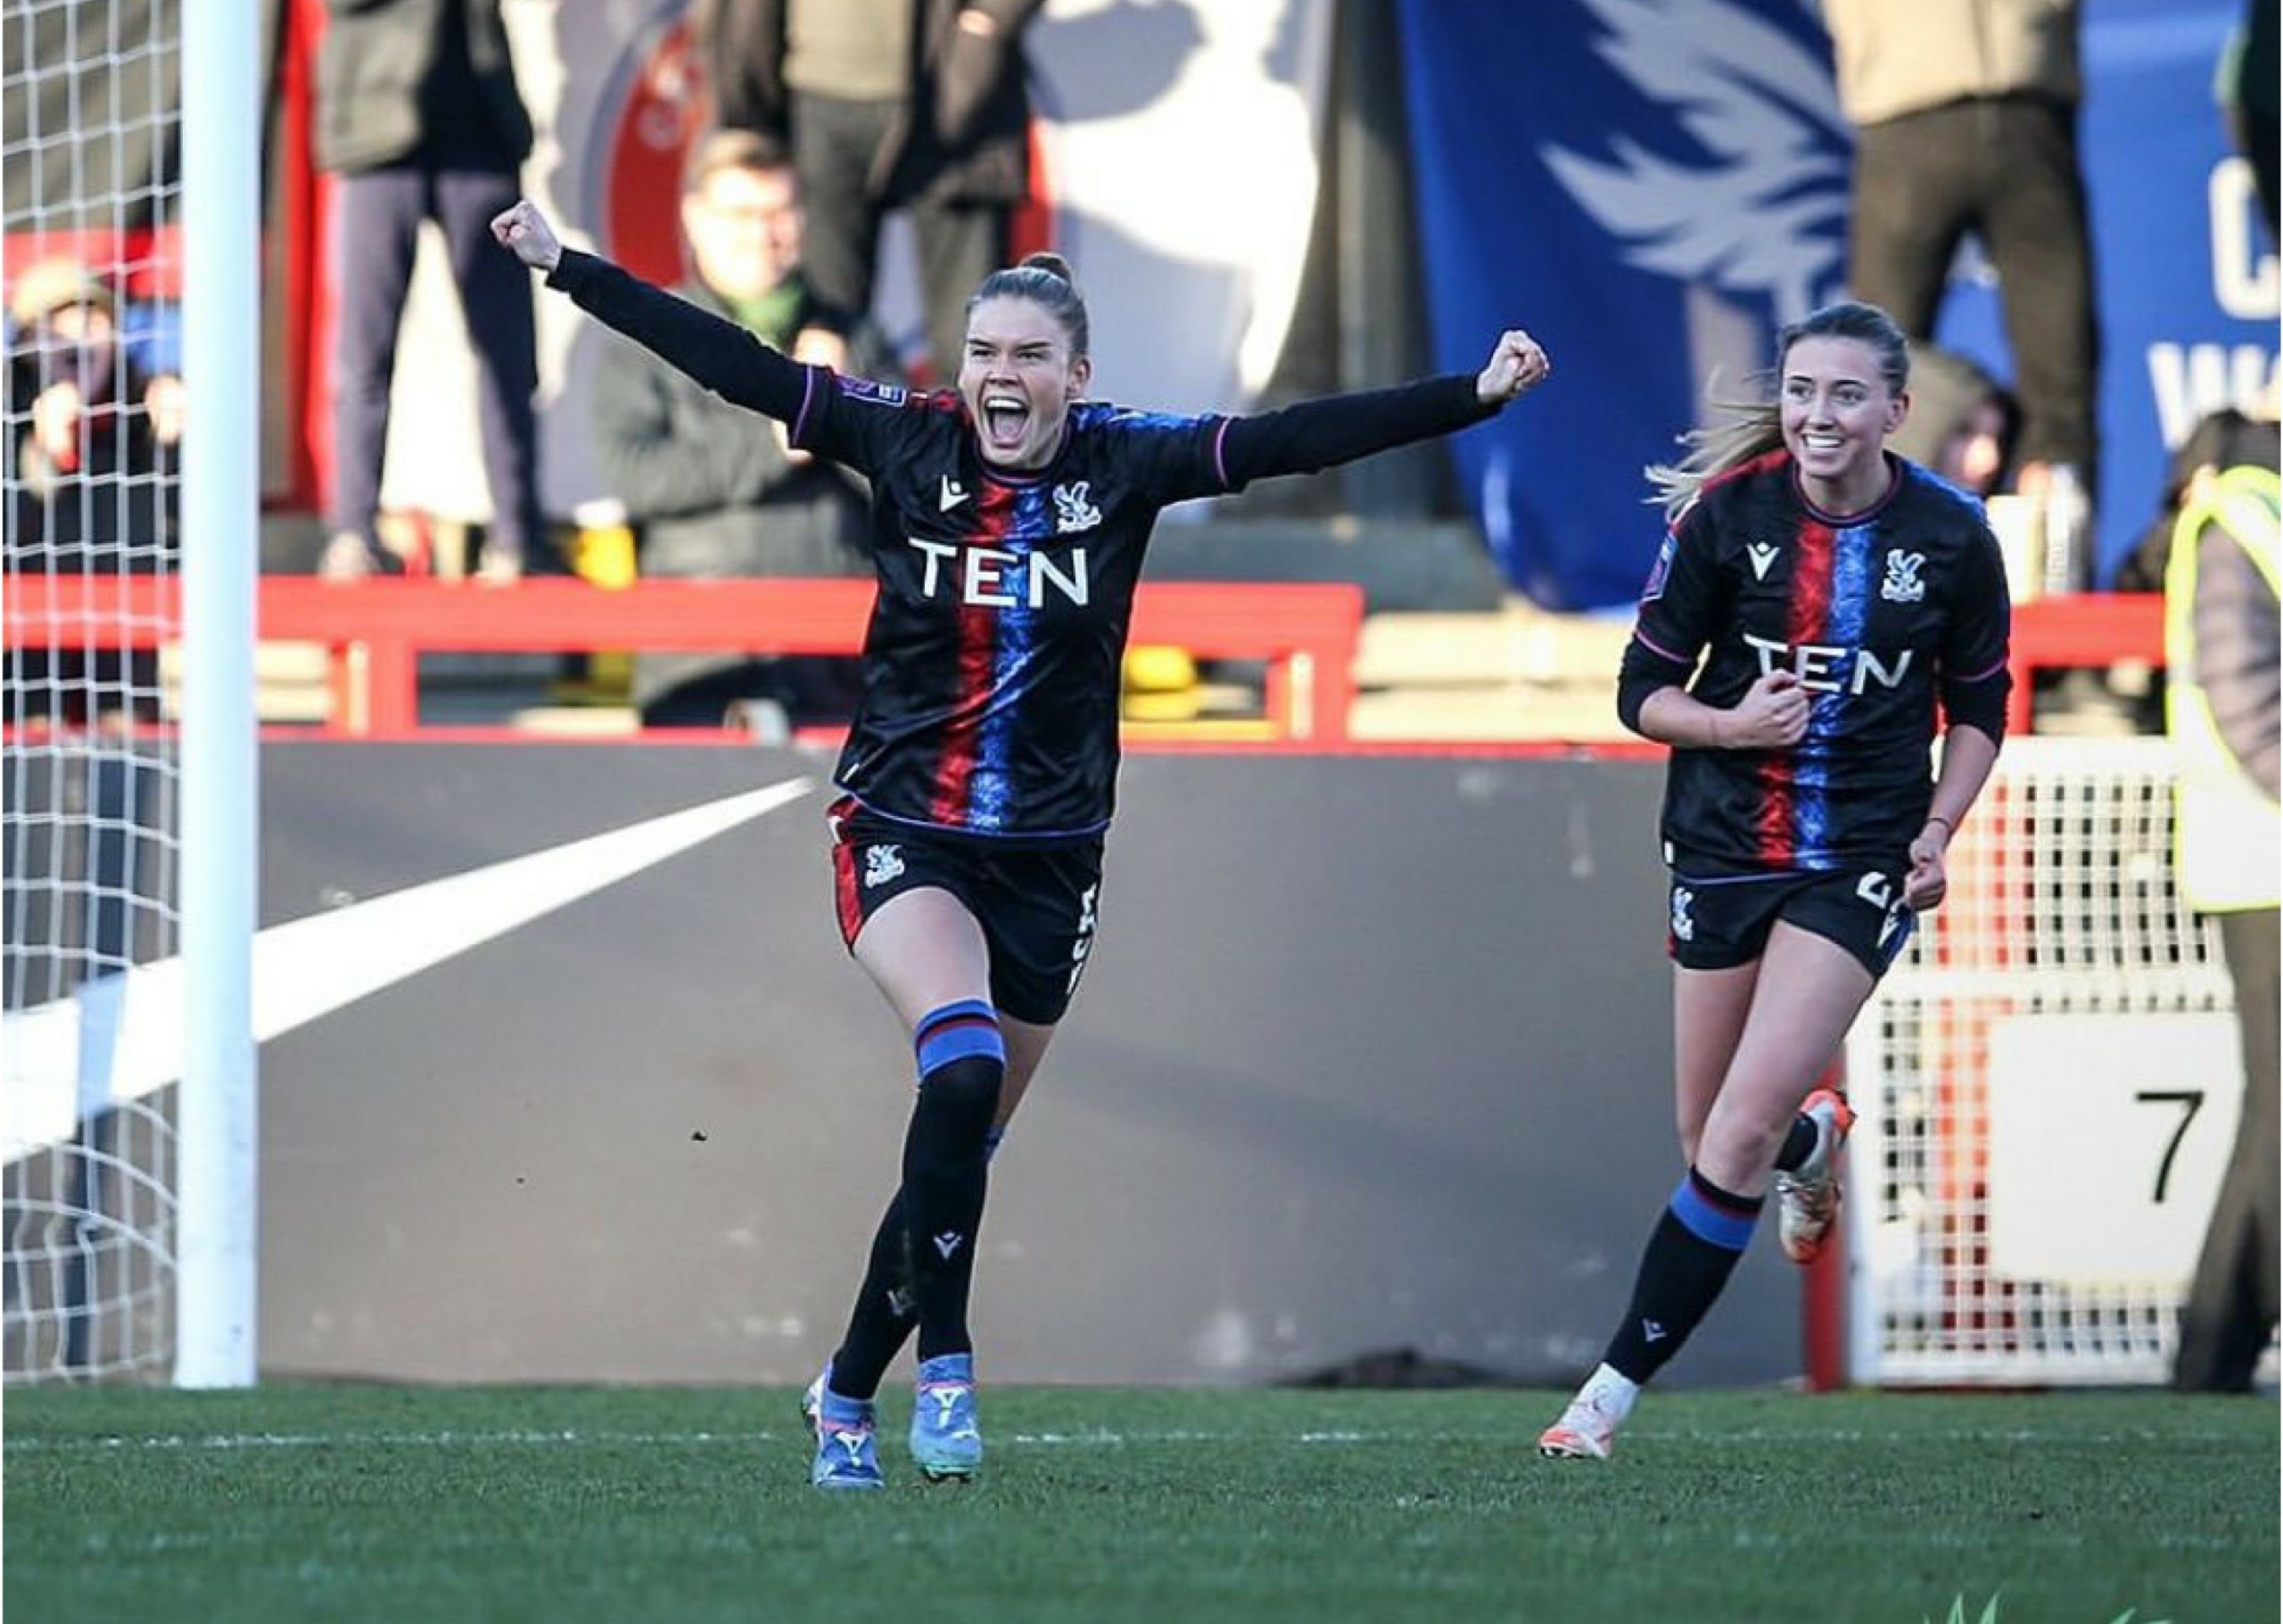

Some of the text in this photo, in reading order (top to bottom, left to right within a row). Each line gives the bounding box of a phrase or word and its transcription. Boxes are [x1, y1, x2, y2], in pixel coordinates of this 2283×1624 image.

[908, 537, 1089, 607] TEN
[1743, 634, 1912, 695] TEN
[2136, 1091, 2205, 1203] 7
